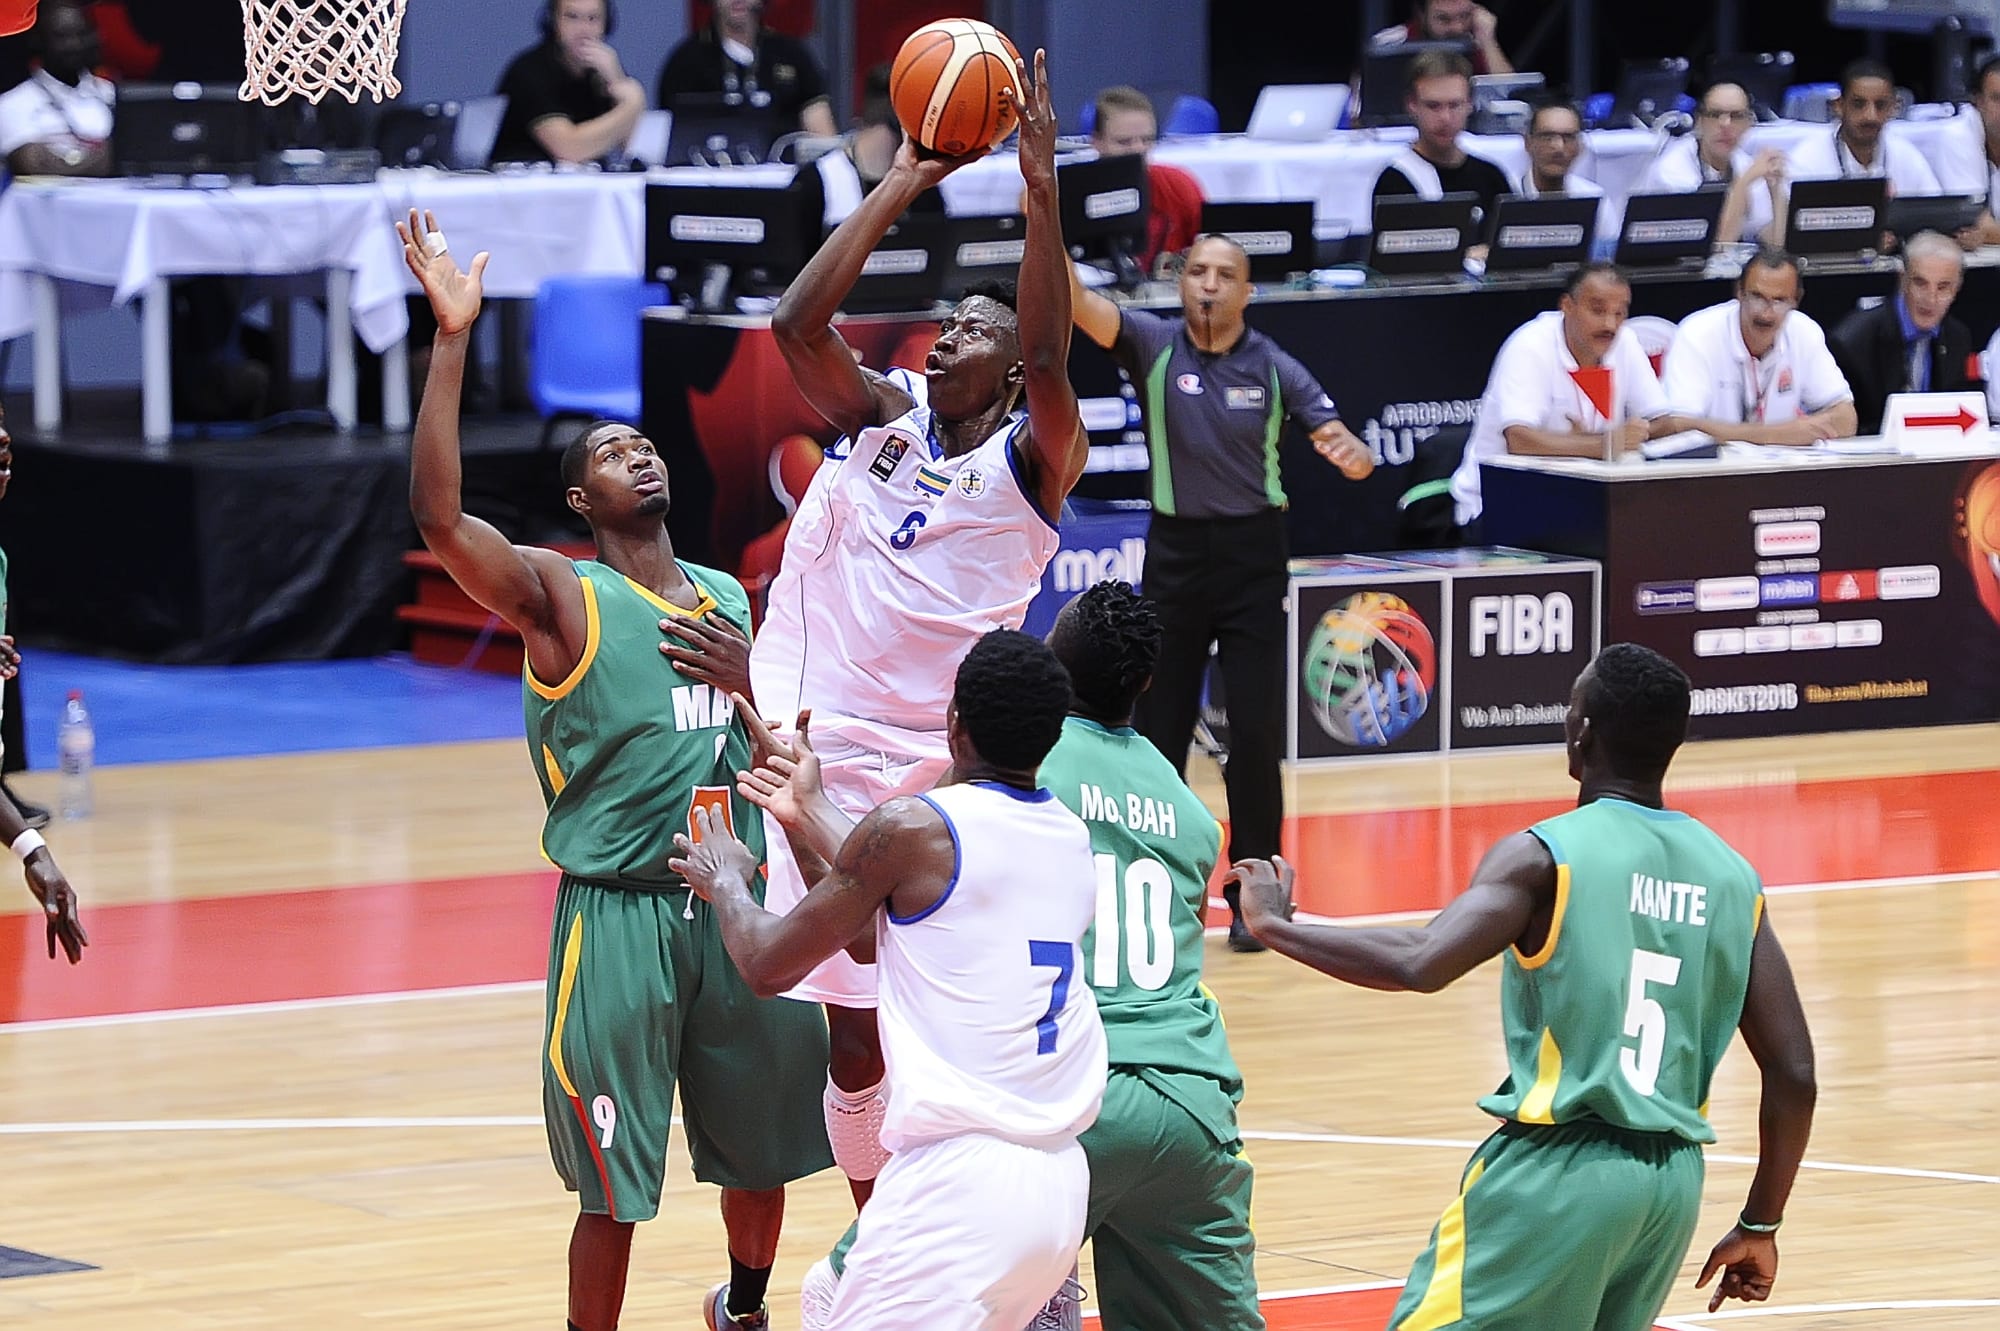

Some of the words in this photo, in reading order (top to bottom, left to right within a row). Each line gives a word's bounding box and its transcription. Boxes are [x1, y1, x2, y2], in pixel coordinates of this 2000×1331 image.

[1469, 591, 1573, 657] FIBA
[1460, 706, 1488, 728] We
[1080, 783, 1125, 825] Mo.
[1126, 793, 1177, 839] BAH
[1093, 853, 1175, 991] 10
[1630, 872, 1708, 926] KANTE
[1028, 939, 1075, 1056] 7
[1619, 948, 1683, 1097] 5
[592, 1094, 617, 1149] 9
